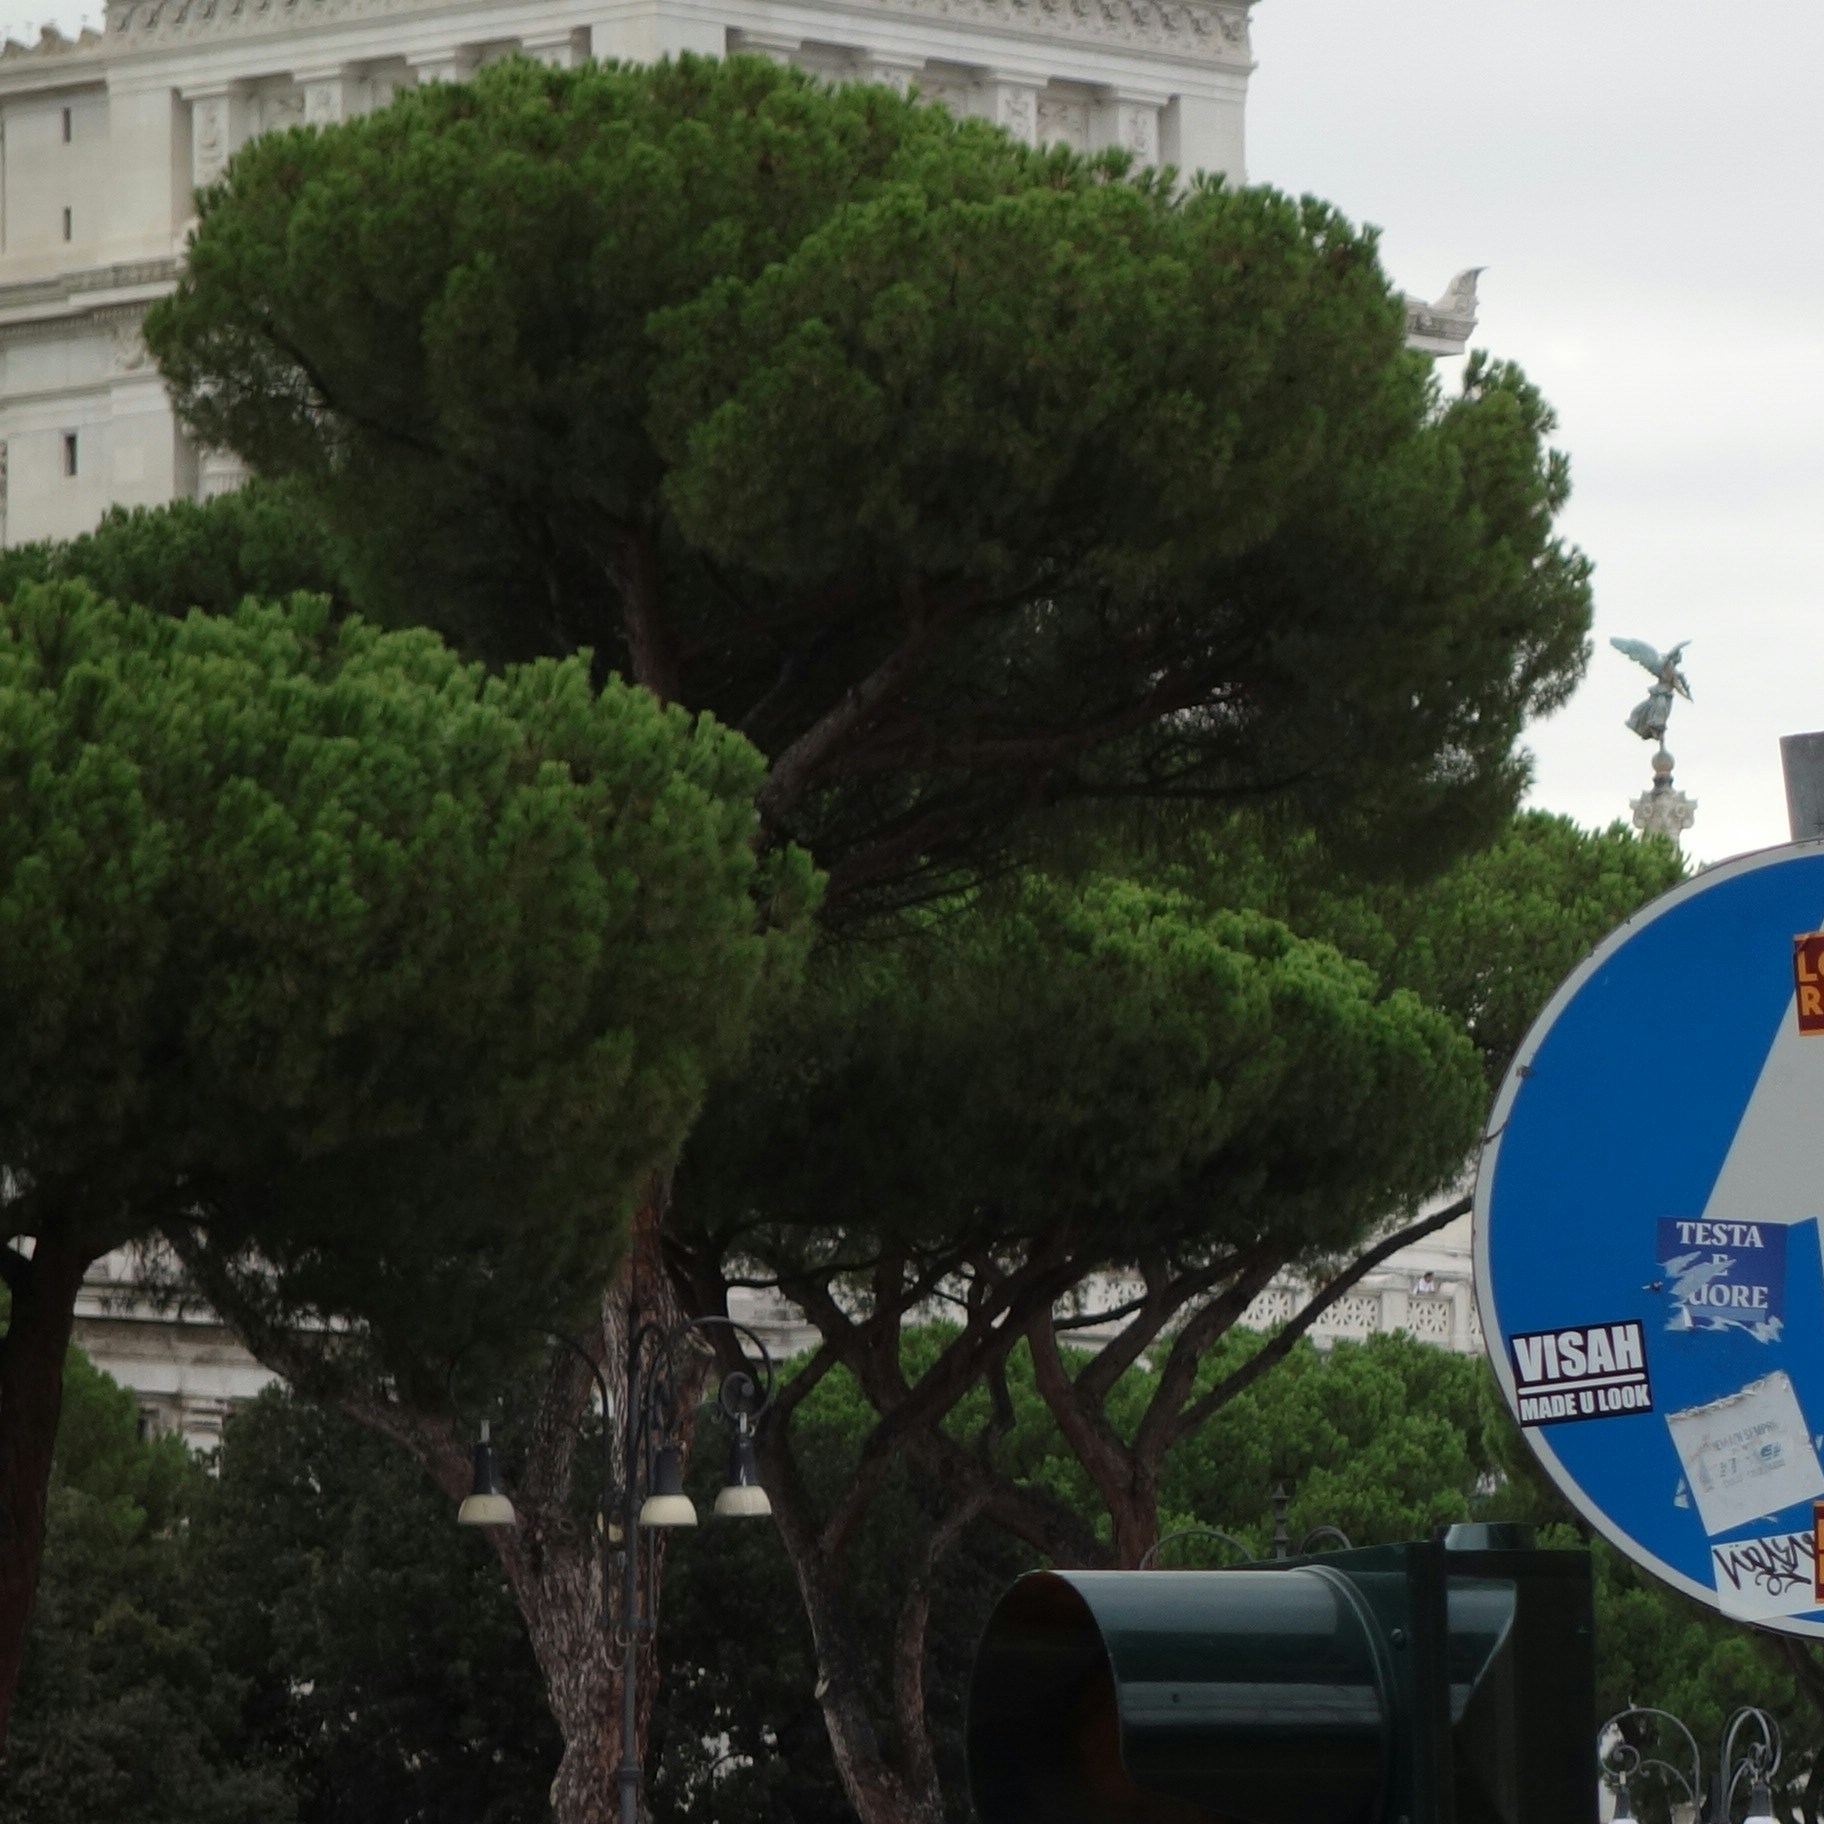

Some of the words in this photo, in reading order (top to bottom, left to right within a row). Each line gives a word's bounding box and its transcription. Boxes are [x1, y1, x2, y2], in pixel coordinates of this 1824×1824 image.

[1676, 1222, 1764, 1248] TESTA
[1688, 1286, 1768, 1309] UORE
[1512, 1324, 1644, 1382] VISAH
[1519, 1395, 1577, 1421] MADE
[1581, 1391, 1594, 1414] U
[1599, 1384, 1650, 1412] LOOK
